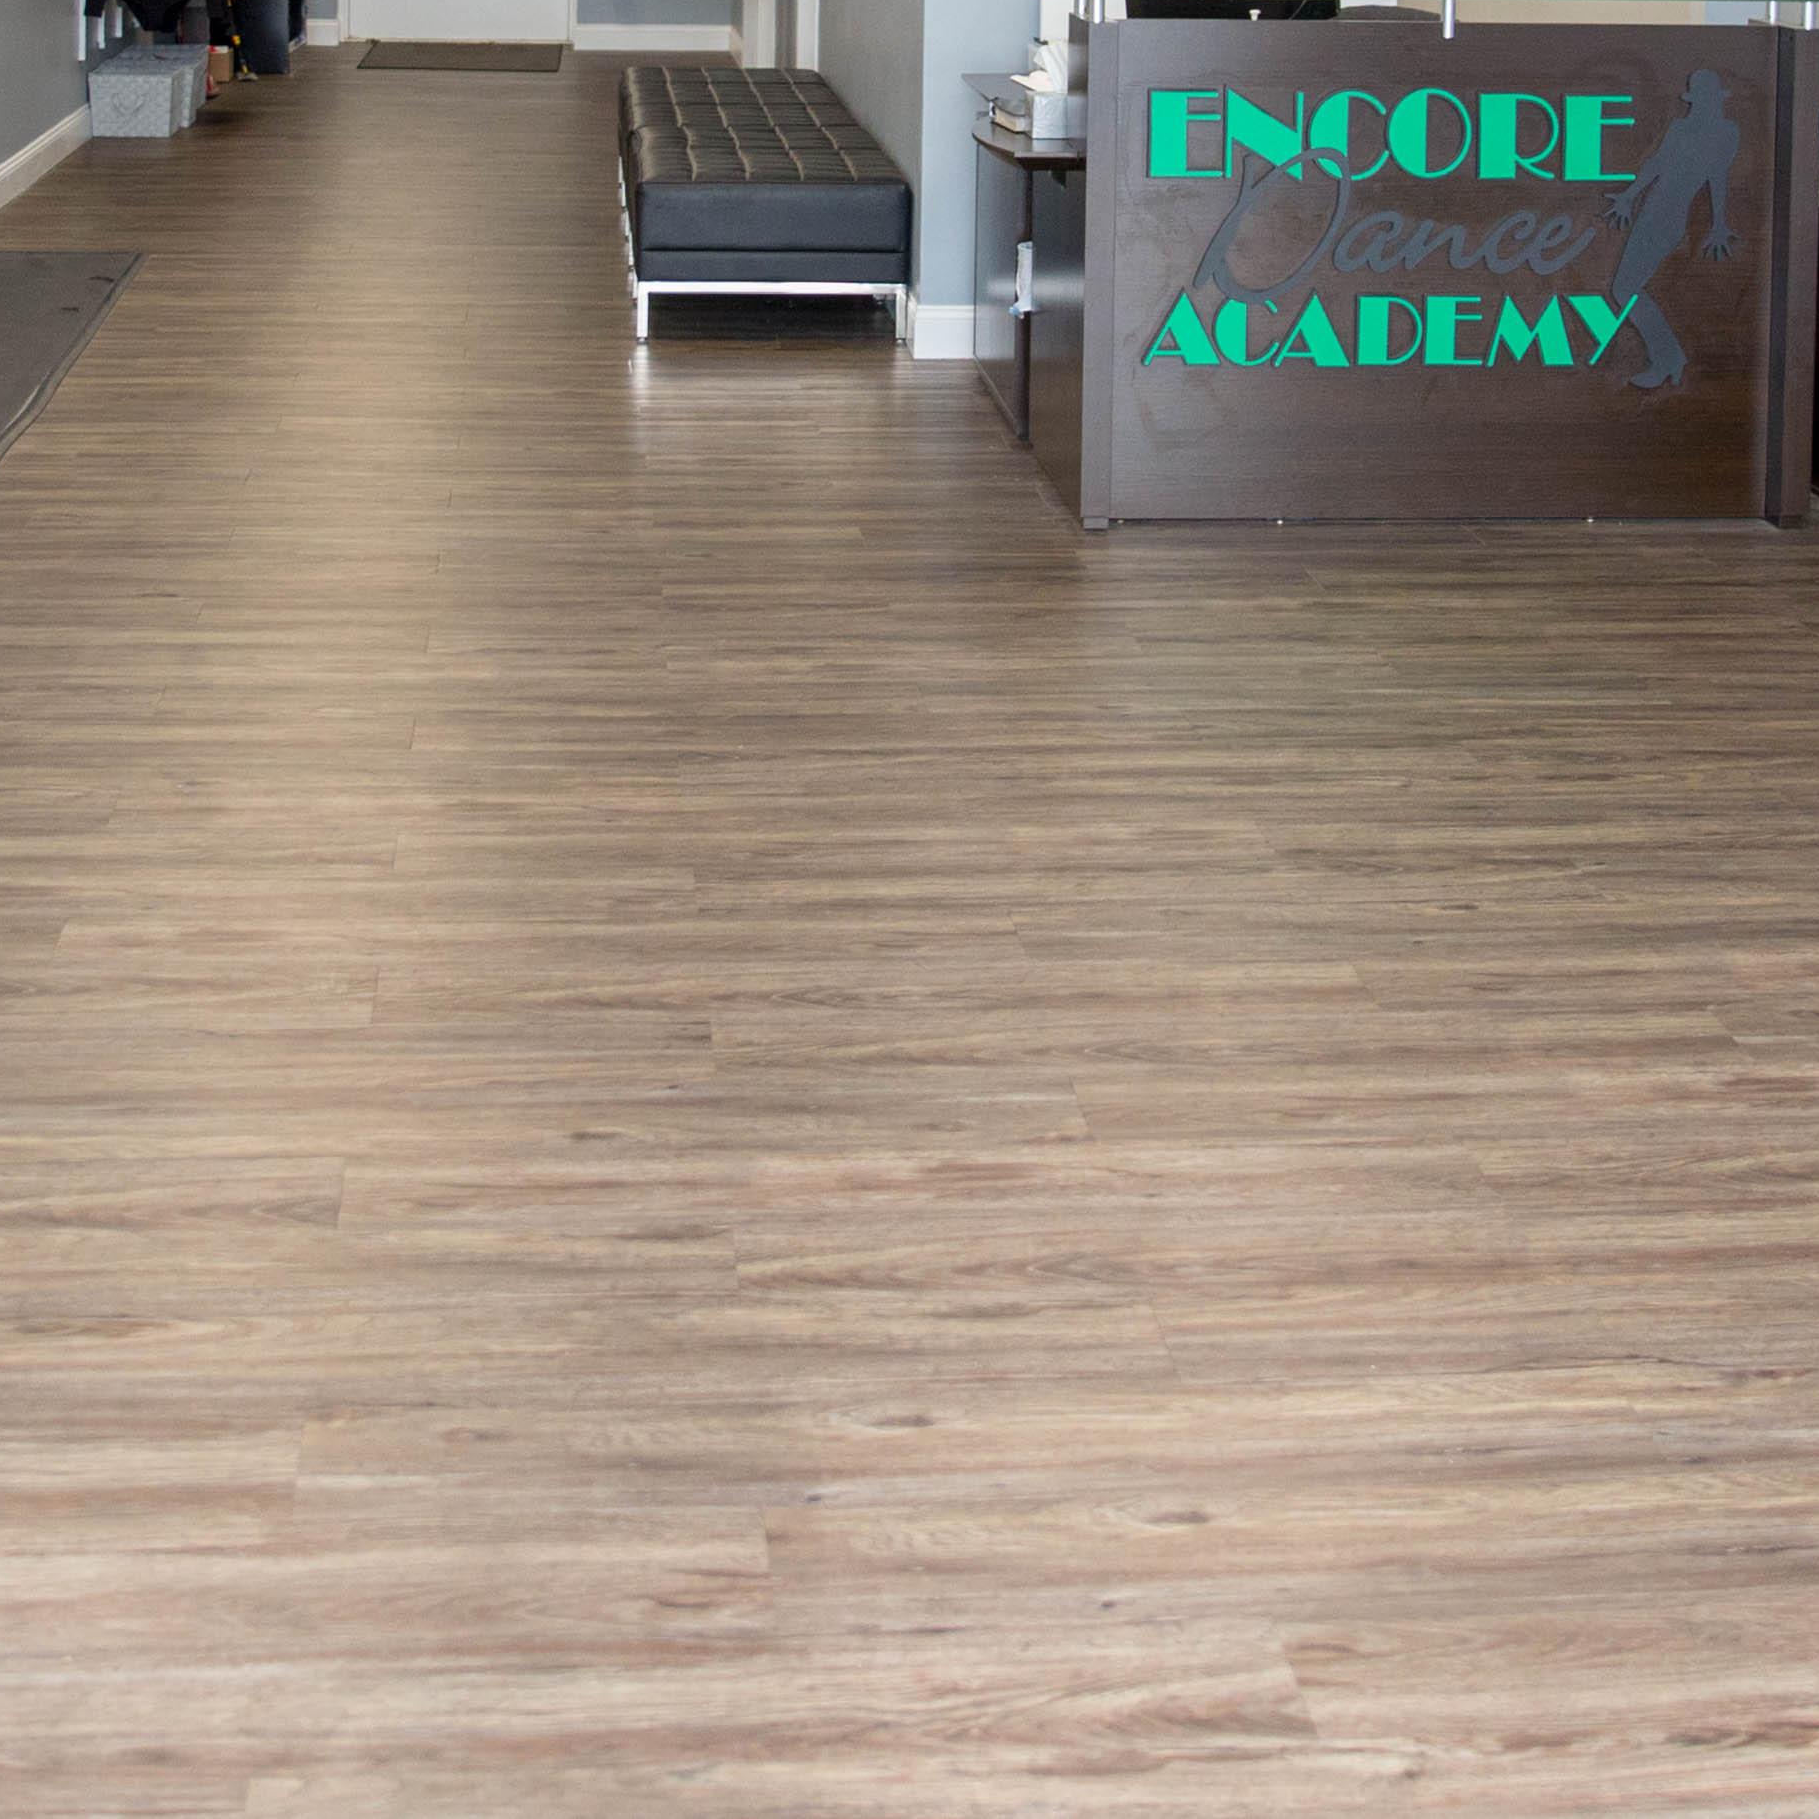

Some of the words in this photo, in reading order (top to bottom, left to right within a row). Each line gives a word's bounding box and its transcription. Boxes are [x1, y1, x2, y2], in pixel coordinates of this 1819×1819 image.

[1147, 88, 1637, 181] ENCORE
[1193, 146, 1596, 305] Dance
[1140, 290, 1639, 368] ACADEMY
